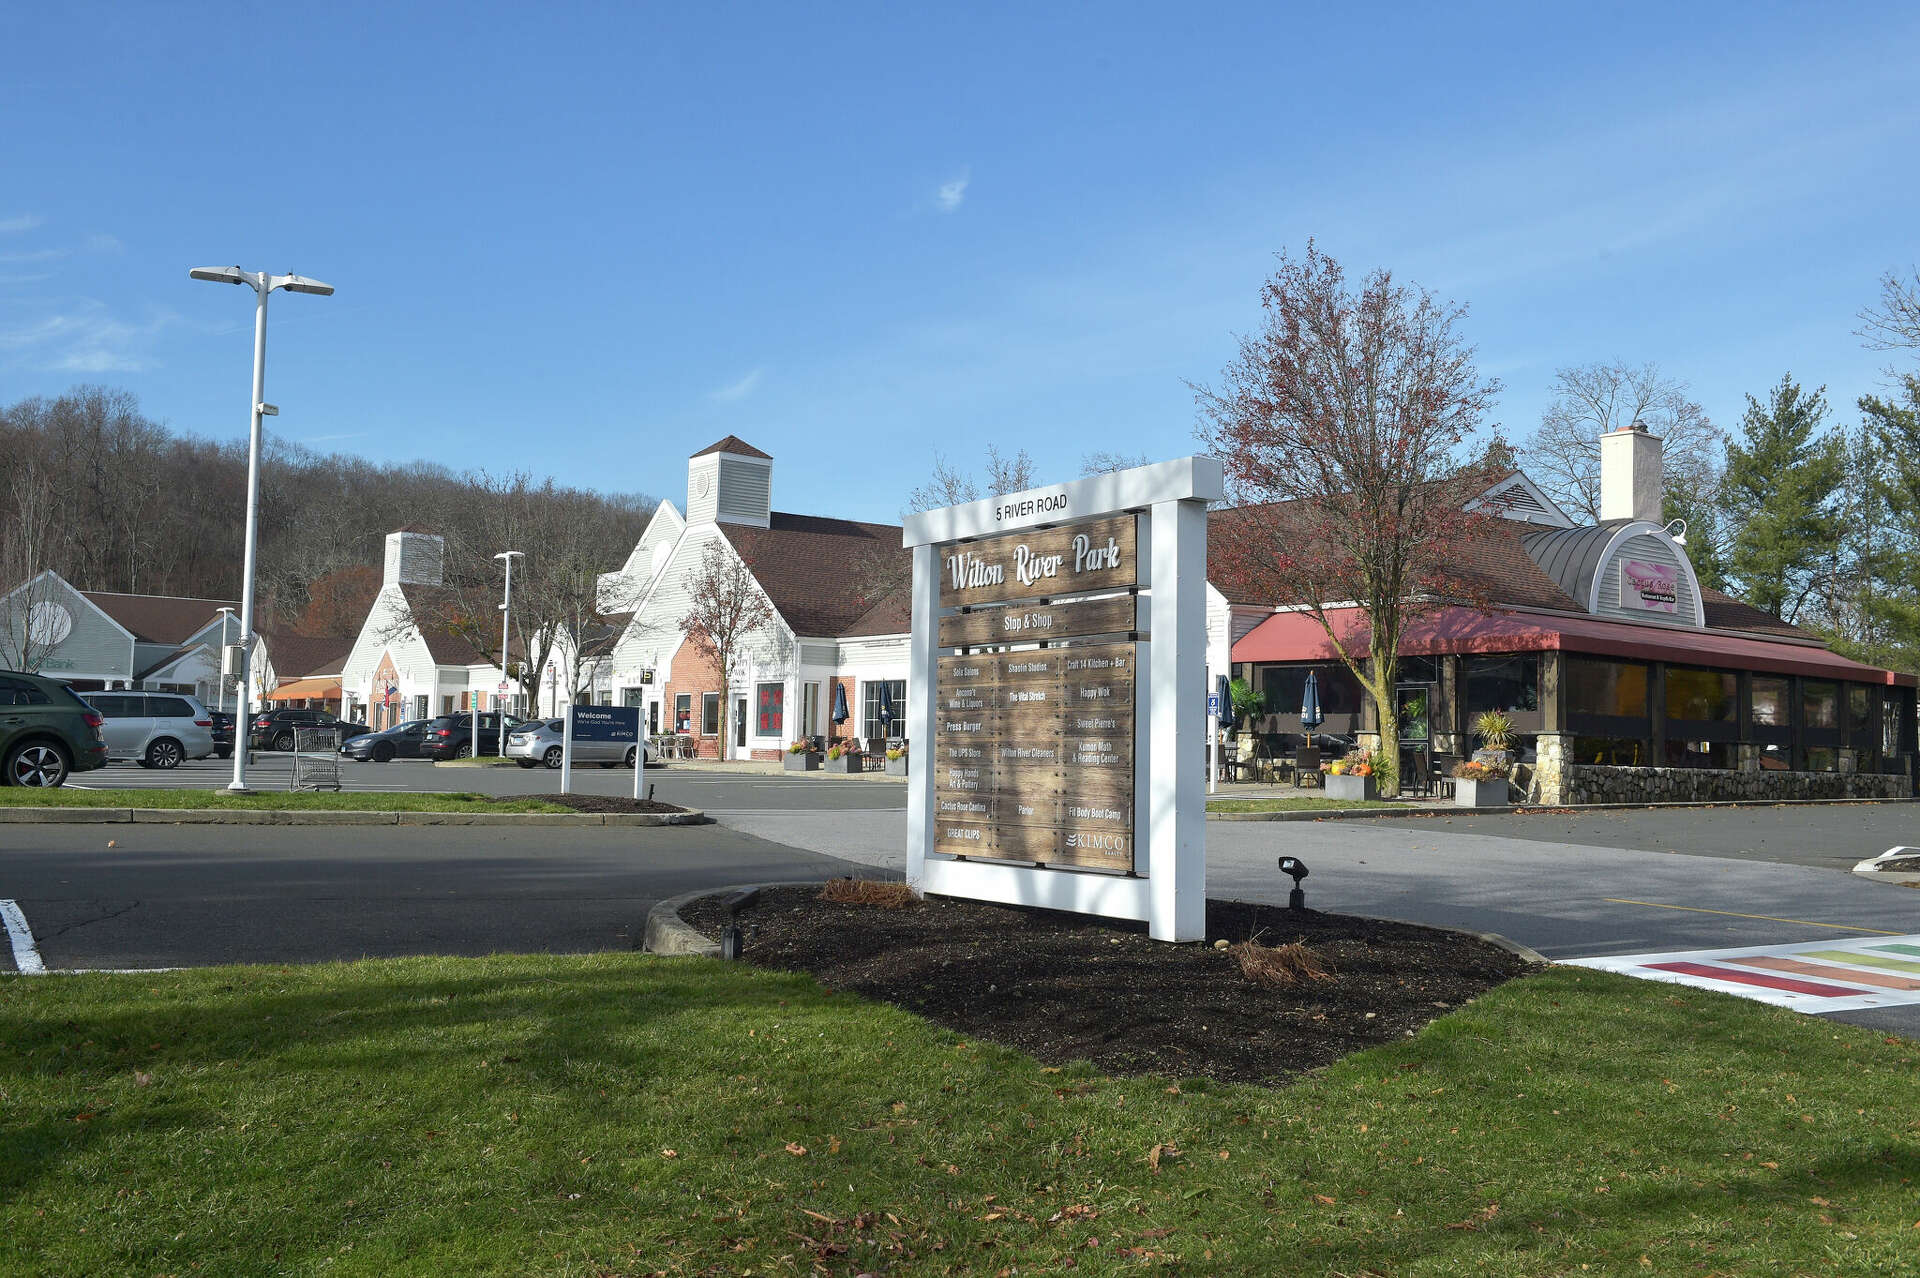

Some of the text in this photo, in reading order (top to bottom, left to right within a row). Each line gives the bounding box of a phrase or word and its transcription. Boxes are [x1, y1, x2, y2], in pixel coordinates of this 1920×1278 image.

[996, 494, 1068, 521] 5 RIVER ROAD
[946, 533, 1121, 590] Wilton River Park
[1004, 612, 1052, 632] Stop & Shop
[1008, 662, 1047, 673] Shaolin Studios
[1068, 660, 1079, 670] Craft
[1080, 660, 1086, 668] 14
[1088, 658, 1108, 668] Kitchen
[1115, 657, 1126, 668] Bar
[1009, 692, 1018, 702] The
[1029, 691, 1046, 701] Stretch
[1080, 688, 1110, 699] Happy Wok
[946, 722, 982, 732] Press Burger
[1077, 719, 1094, 728] Sweet
[958, 748, 968, 757] UPS
[969, 748, 981, 757] Store
[1079, 742, 1112, 752] Kumon Math
[1017, 748, 1031, 758] River
[1032, 748, 1055, 758] Cleaners
[1077, 753, 1100, 764] Reading
[1100, 753, 1119, 763] Center
[957, 780, 961, 788] &
[941, 802, 957, 811] Cactus
[957, 802, 968, 812] Rose
[1077, 807, 1091, 819] Body
[1091, 808, 1104, 818] Boot
[1105, 808, 1121, 821] Camp
[948, 828, 980, 840] GREAT CLIPS
[1078, 834, 1124, 850] KIMCO
